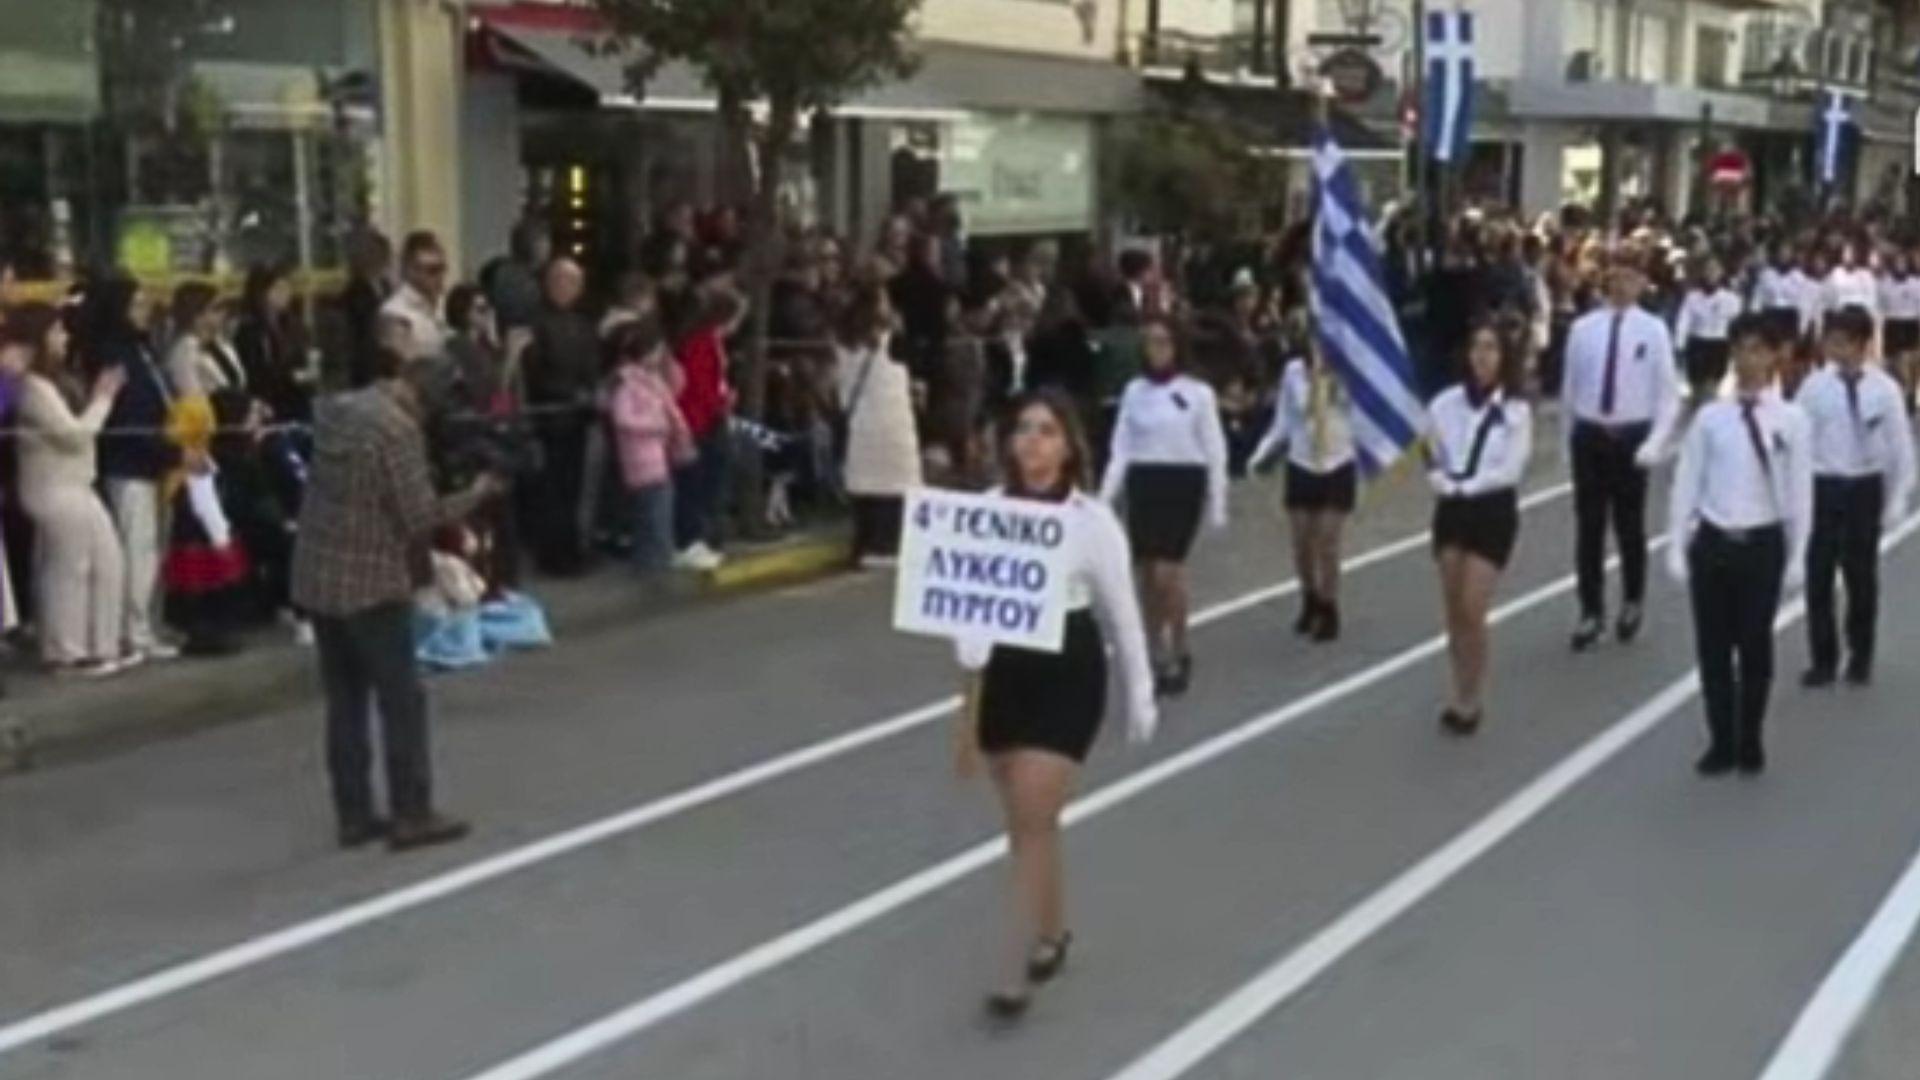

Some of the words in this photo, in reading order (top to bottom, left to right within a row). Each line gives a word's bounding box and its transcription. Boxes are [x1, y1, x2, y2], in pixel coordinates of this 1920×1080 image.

[954, 507, 1063, 548] ΓΕΝΙΚΟ
[926, 547, 1047, 592] ΛΥΚΕΙΟ
[922, 588, 1042, 632] ΠΥΡΓΟΥ
